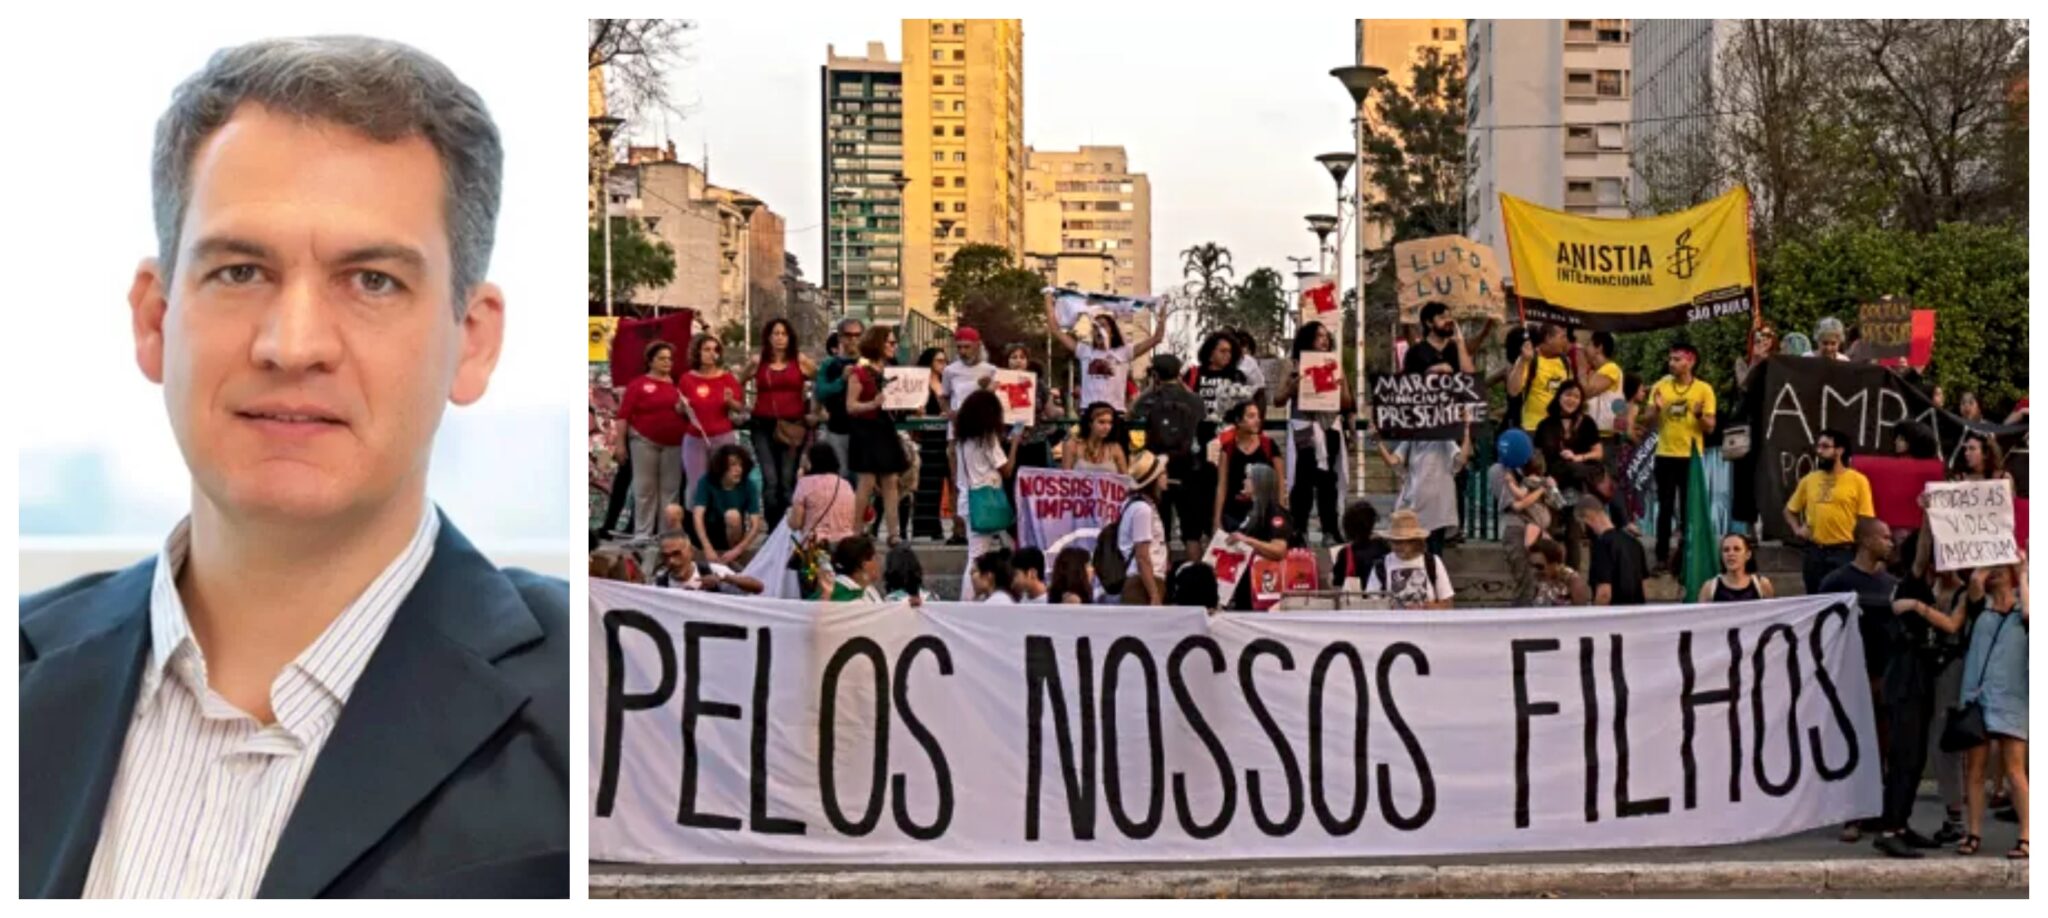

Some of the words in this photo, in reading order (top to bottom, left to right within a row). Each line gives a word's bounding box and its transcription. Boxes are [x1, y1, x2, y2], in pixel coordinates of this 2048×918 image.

[1556, 242, 1653, 272] ANISTIA
[1557, 267, 1655, 287] INTERNACIONAL
[1713, 298, 1750, 317] PAULO
[1019, 475, 1094, 498] NOSSAS
[1099, 479, 1127, 502] VID
[1932, 487, 1979, 509] TODAS
[1984, 485, 2006, 507] AS
[1945, 511, 1999, 535] VIDAS
[1940, 539, 2016, 565] IMPORTAM
[596, 609, 955, 841] PELOS
[1025, 635, 1437, 841] NOSSOS
[1511, 601, 1860, 829] FILHOS
